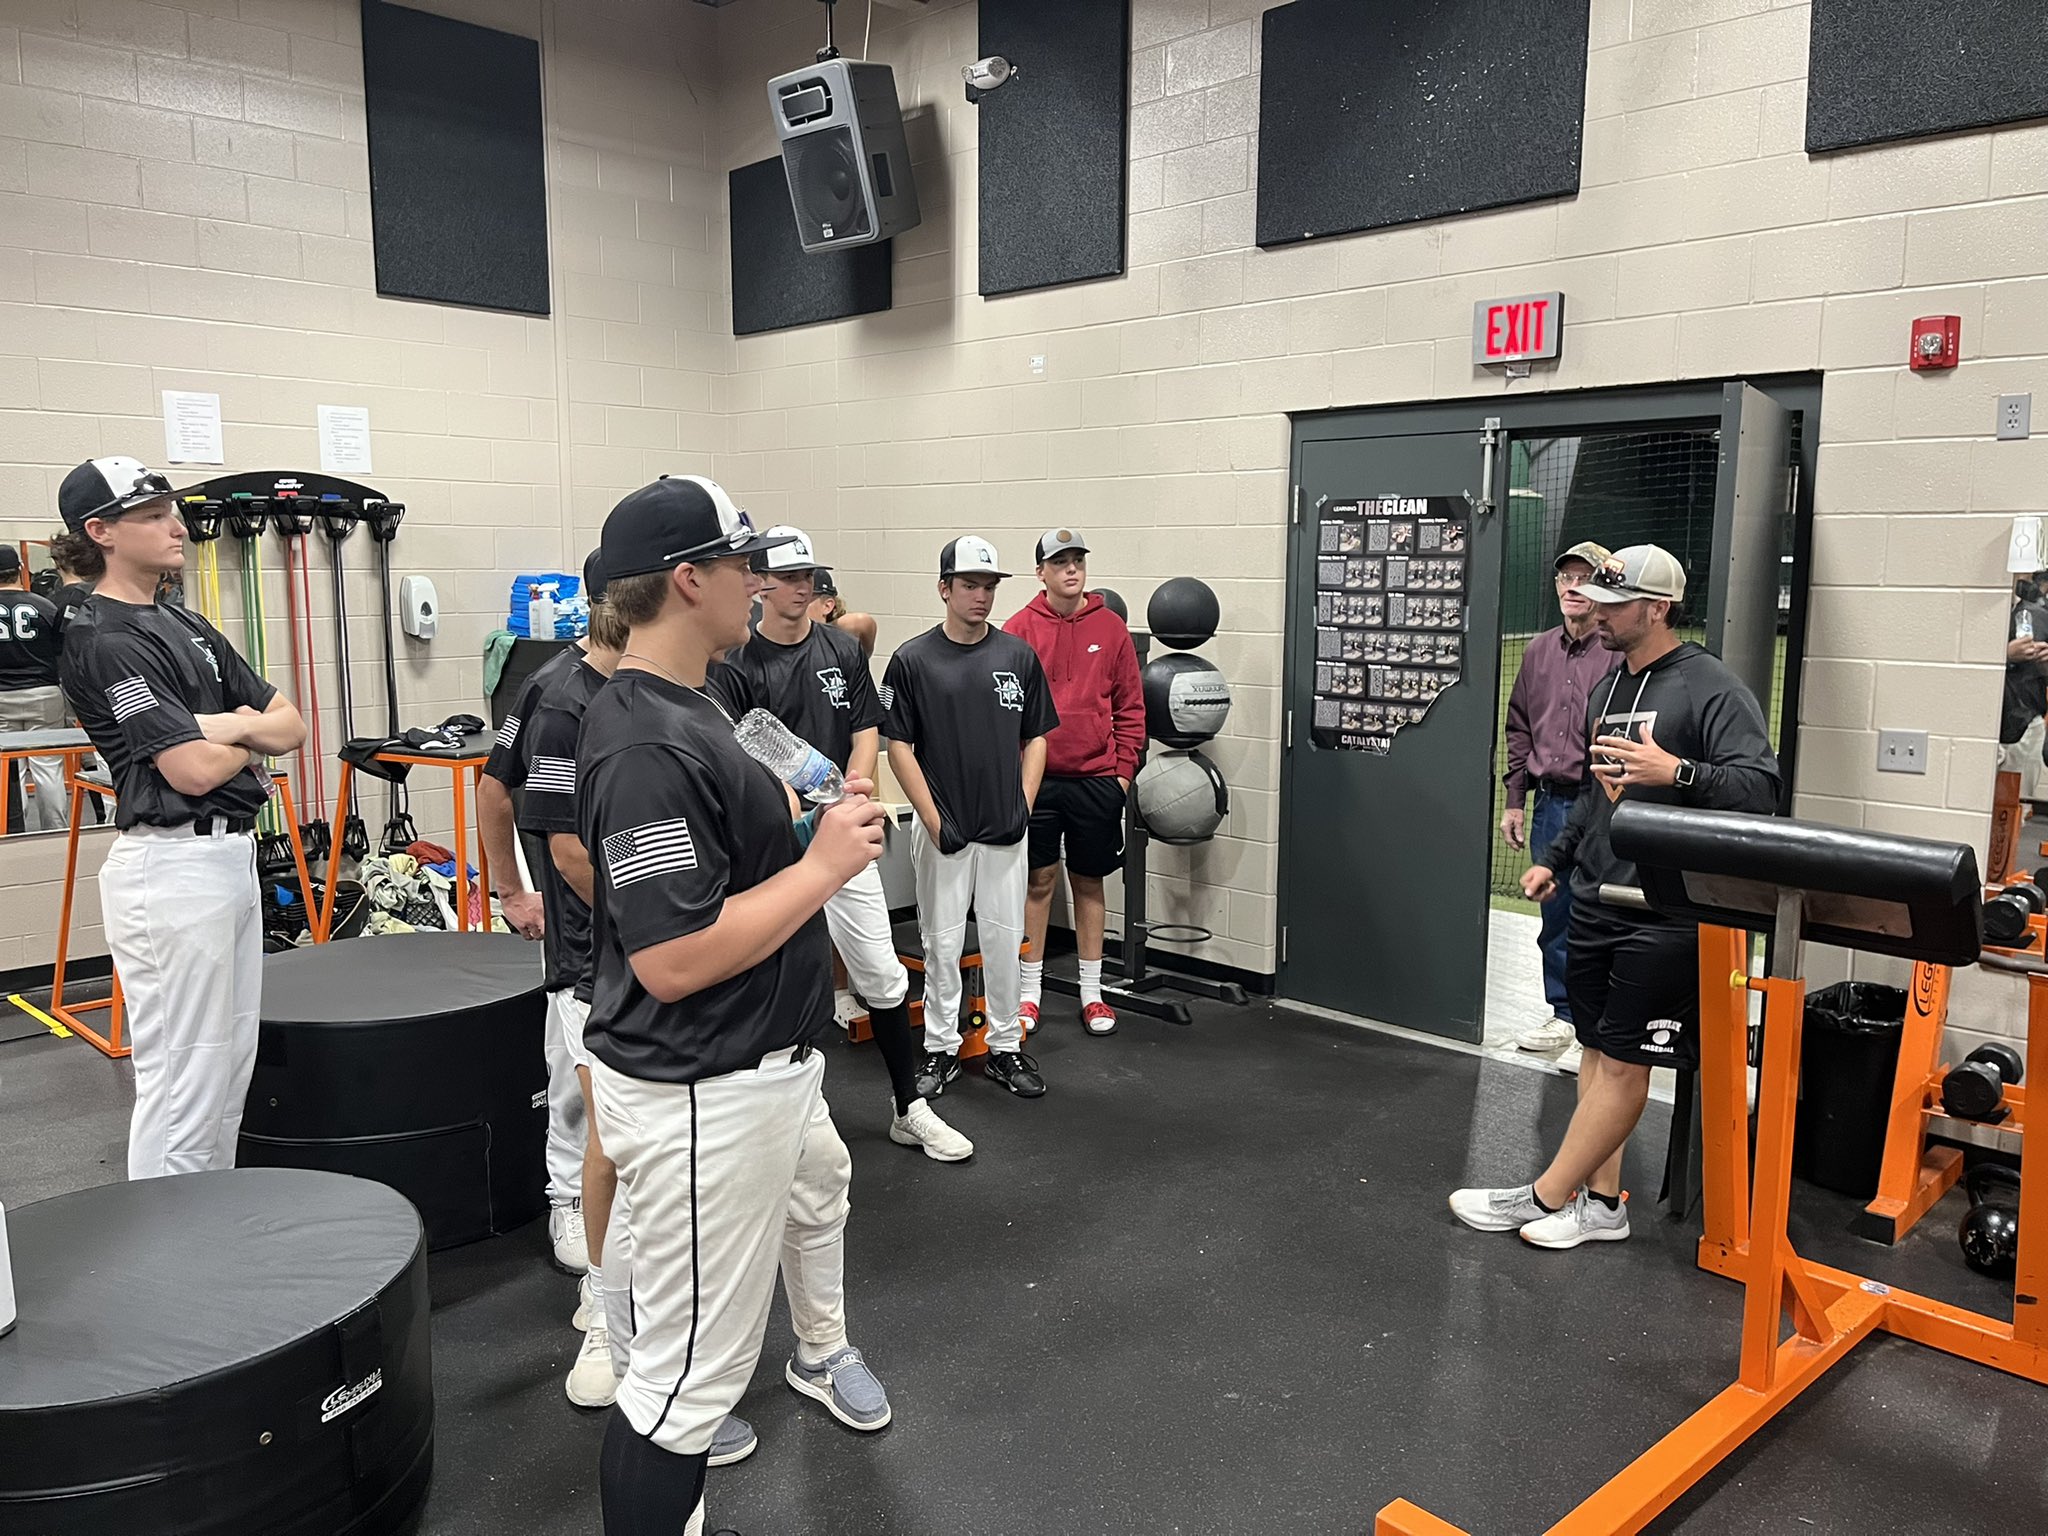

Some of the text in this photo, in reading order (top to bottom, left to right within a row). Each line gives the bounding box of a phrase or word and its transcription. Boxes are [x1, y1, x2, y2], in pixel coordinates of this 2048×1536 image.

[1486, 300, 1549, 356] EXIT
[1919, 963, 1934, 1004] LEG
[1640, 1043, 1675, 1054] BASEBALL
